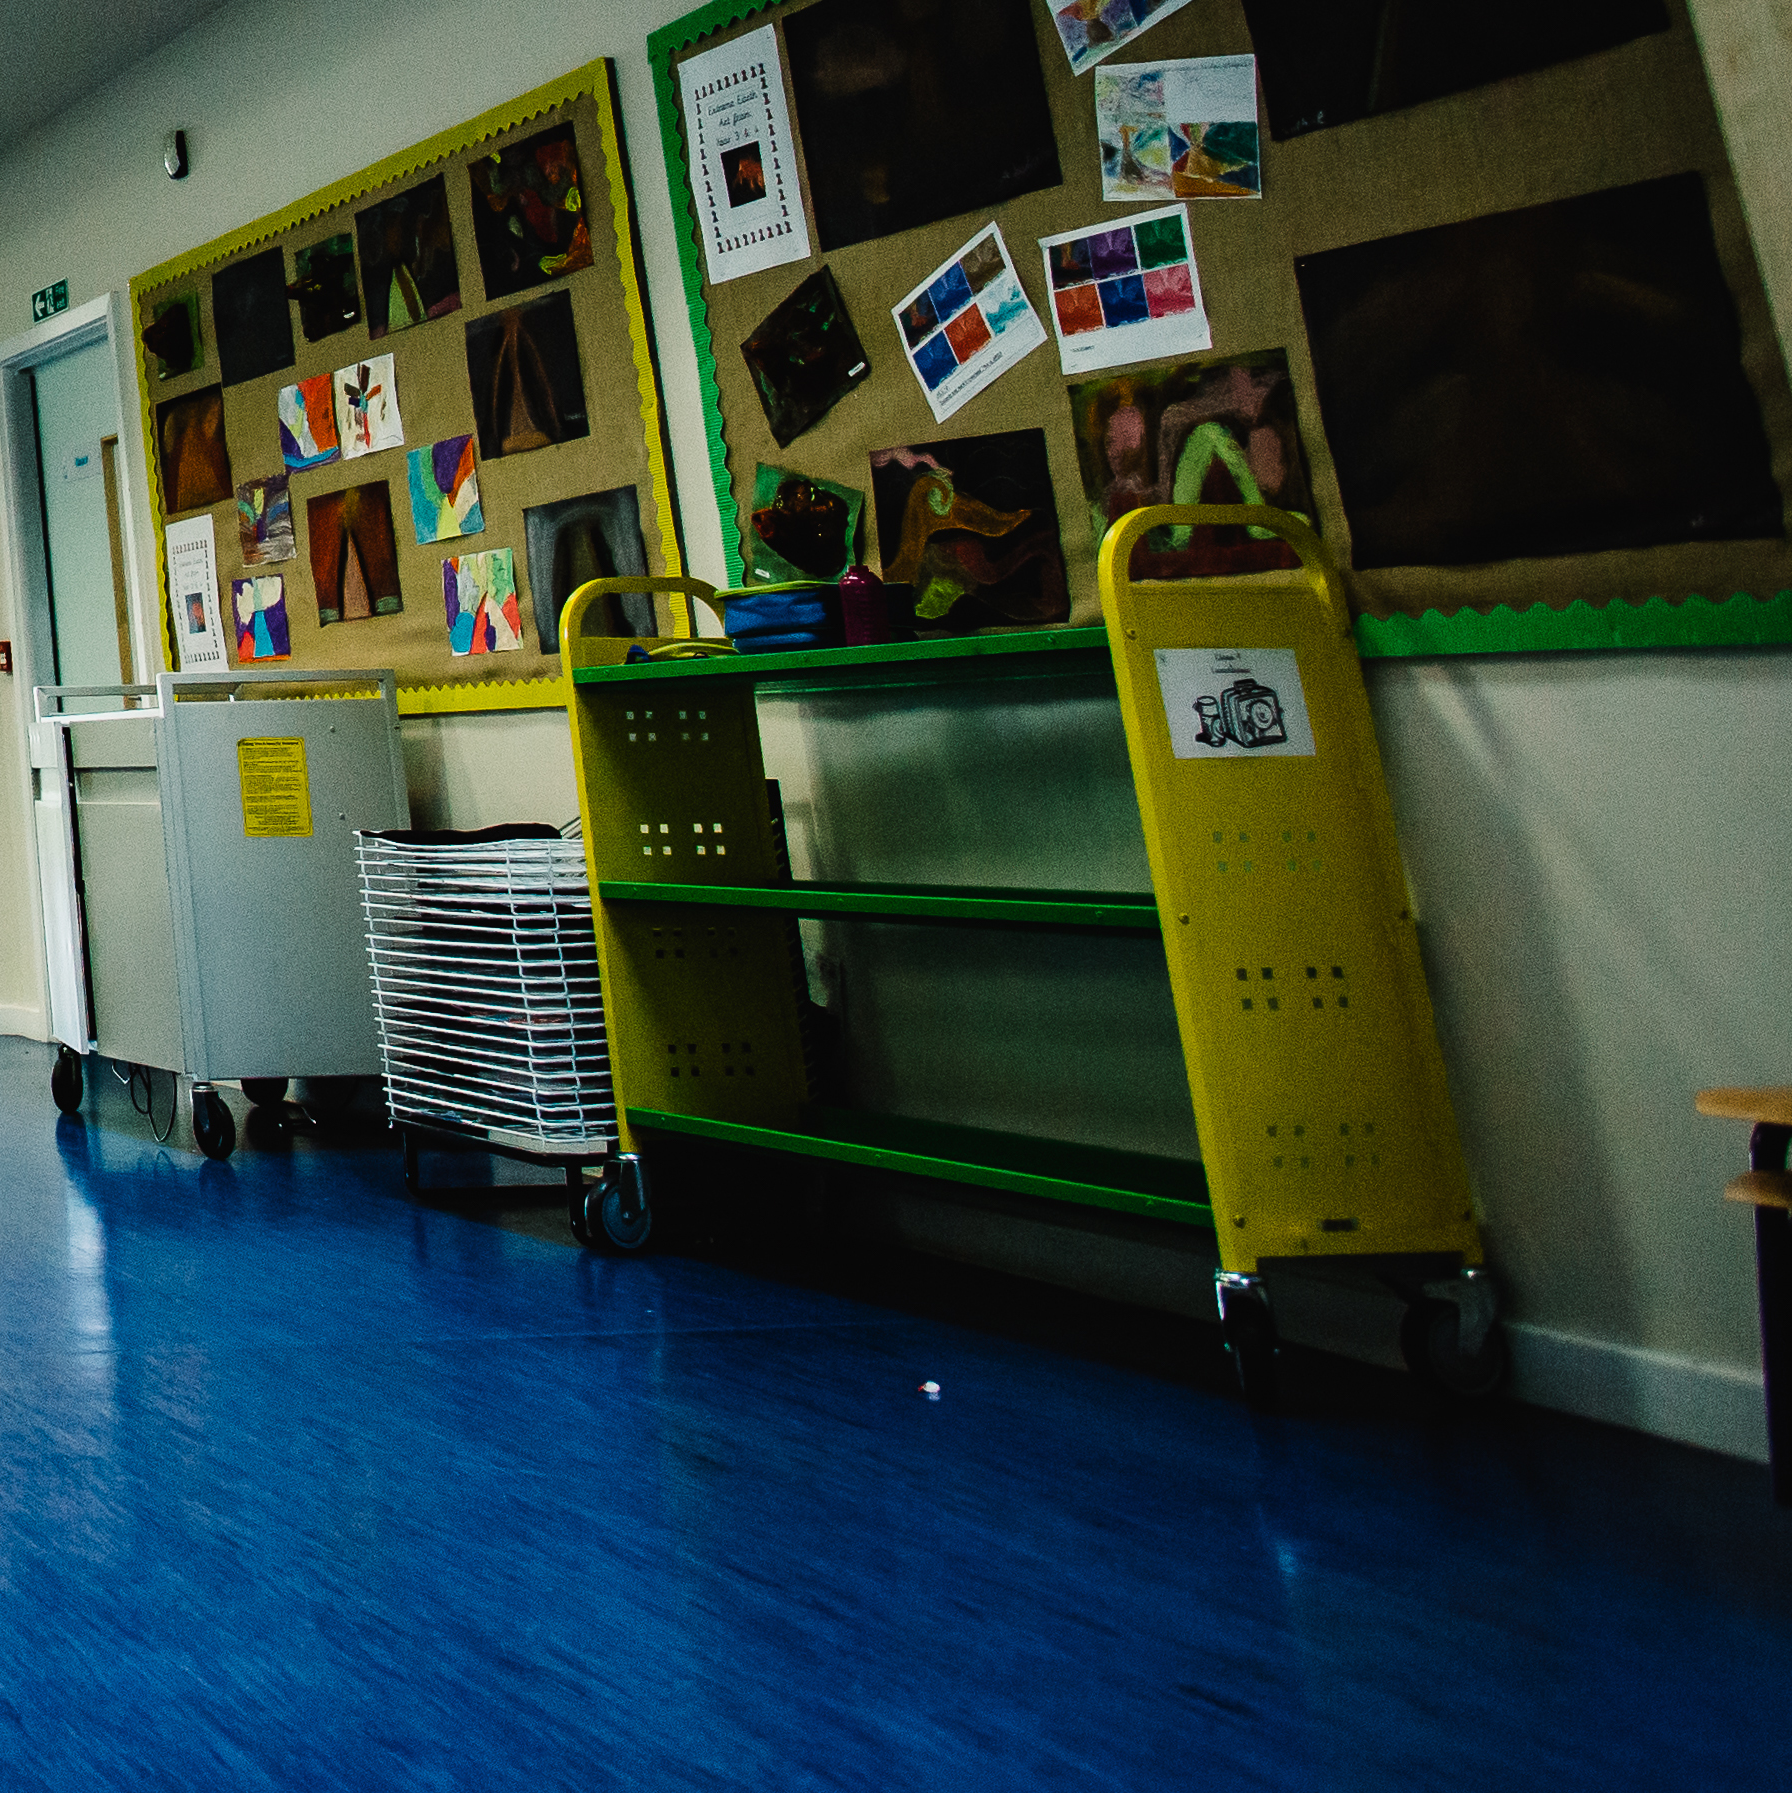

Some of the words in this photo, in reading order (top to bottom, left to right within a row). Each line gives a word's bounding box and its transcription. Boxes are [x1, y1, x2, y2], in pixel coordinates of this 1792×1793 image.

[708, 100, 735, 116] Extreme
[737, 91, 758, 105] Earth
[719, 117, 731, 127] Art
[734, 130, 740, 141] 3
